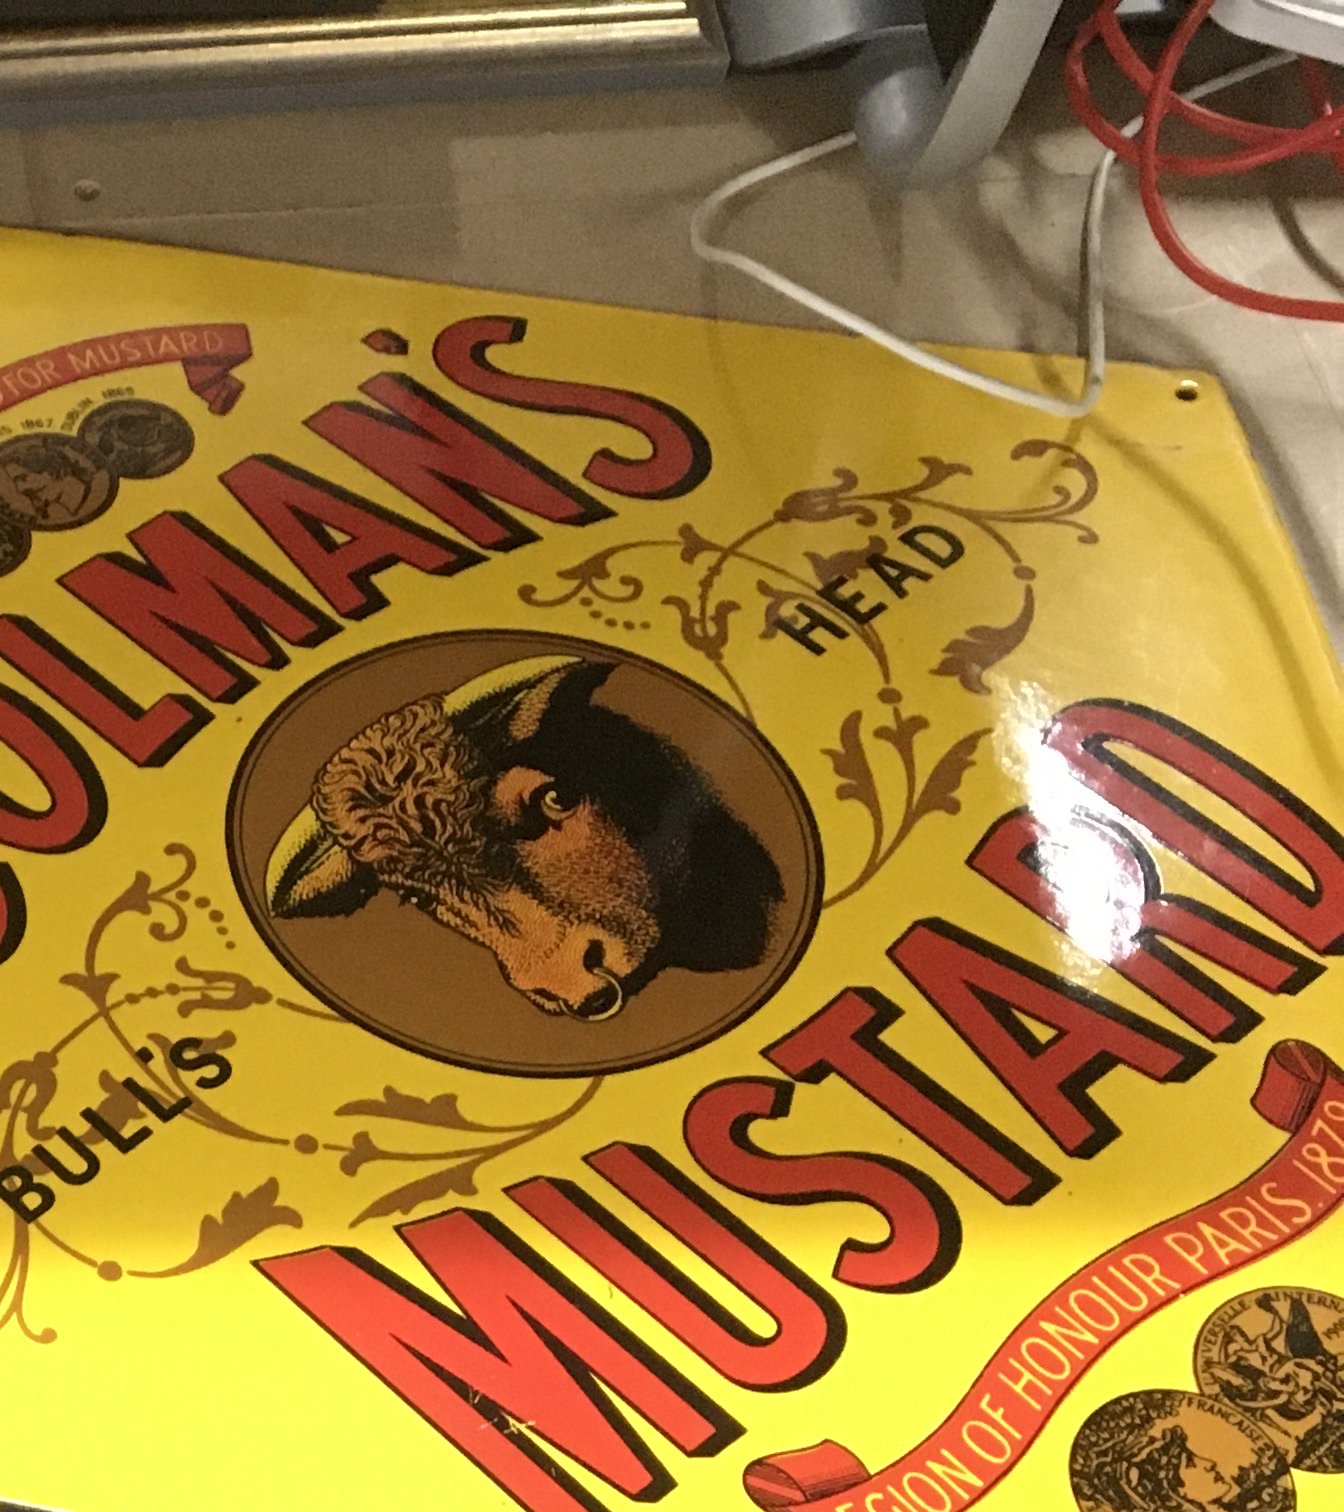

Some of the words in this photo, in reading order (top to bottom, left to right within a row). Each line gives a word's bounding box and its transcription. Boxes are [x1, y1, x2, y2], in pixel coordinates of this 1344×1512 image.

[2, 358, 61, 398] FOR
[66, 330, 225, 374] MUSTARD
[20, 418, 54, 430] 1867
[773, 523, 967, 656] HEAD
[961, 1393, 1023, 1465] OF
[998, 1253, 1182, 1411] HONOUR
